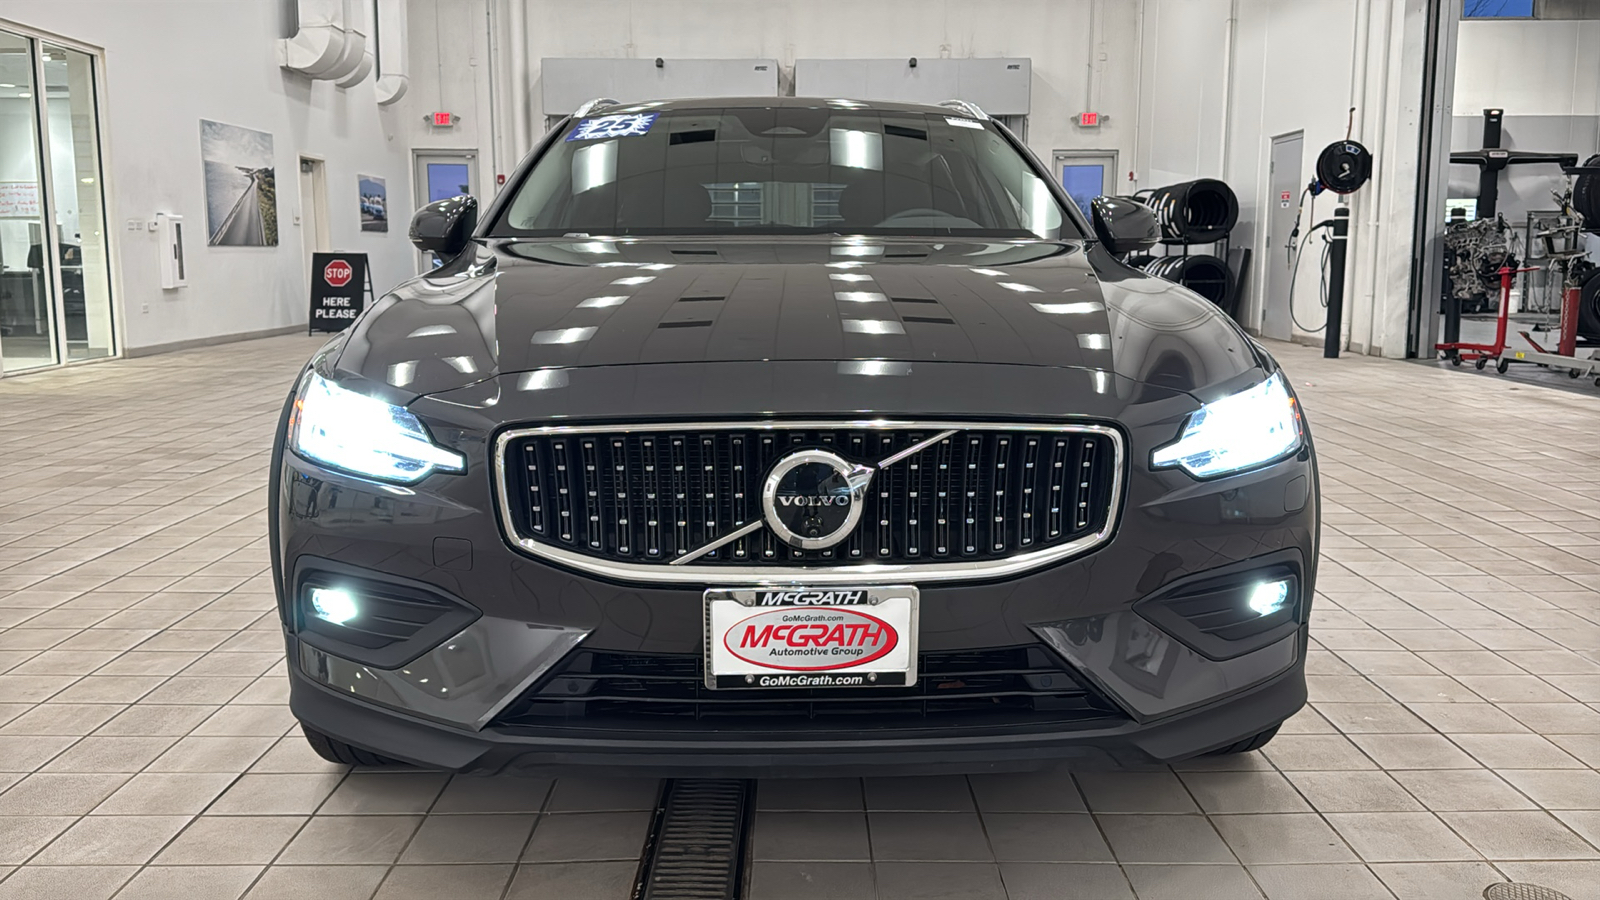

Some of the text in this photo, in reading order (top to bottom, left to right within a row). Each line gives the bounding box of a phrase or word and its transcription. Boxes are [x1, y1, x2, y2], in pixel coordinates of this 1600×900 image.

[589, 118, 637, 134] 25
[326, 268, 350, 278] STOP
[323, 297, 350, 306] HERE
[315, 309, 356, 318] PLEASE
[778, 495, 849, 506] VOLVO
[782, 614, 844, 622] GoMcGrath.com
[769, 647, 863, 656] Automotive Group
[759, 675, 863, 687] GoMcGrath.com
